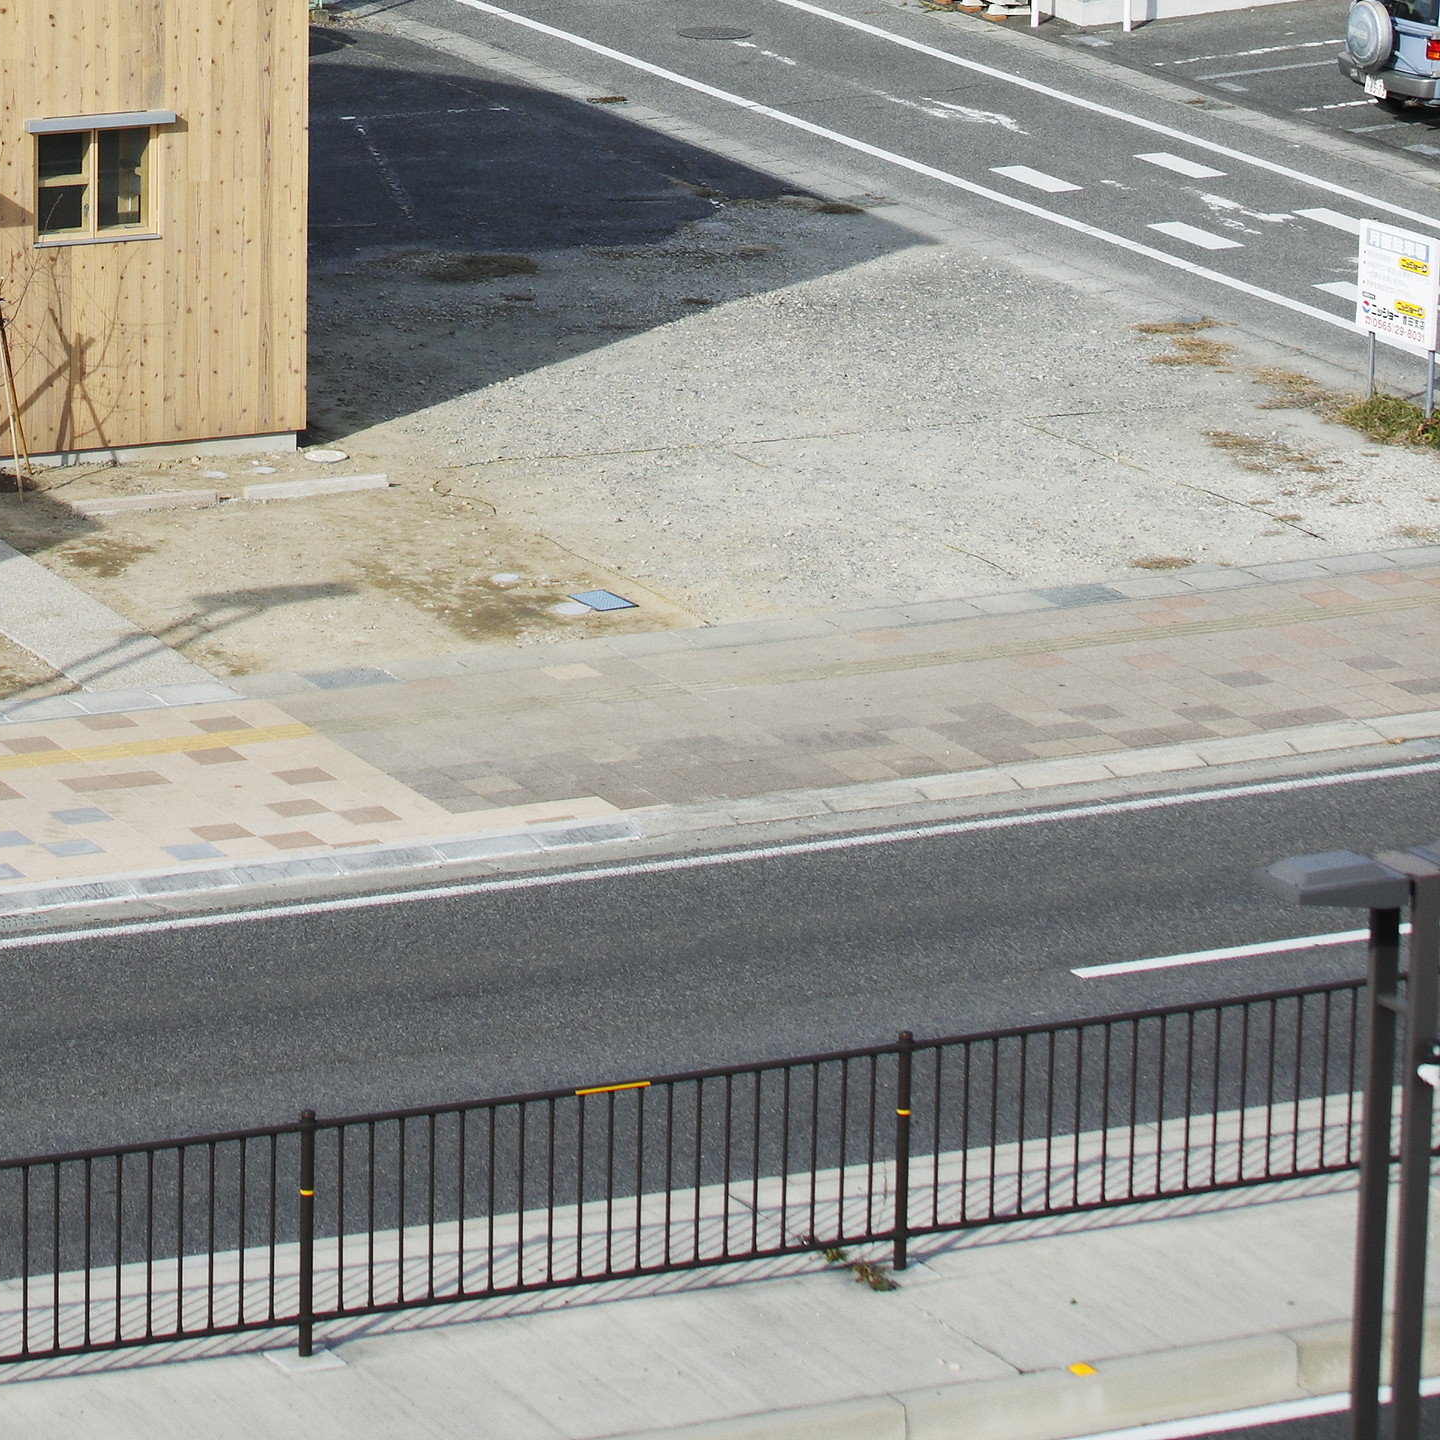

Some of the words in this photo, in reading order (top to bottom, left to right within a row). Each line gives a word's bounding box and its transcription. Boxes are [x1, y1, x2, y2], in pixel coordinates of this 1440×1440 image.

[1371, 304, 1399, 320] ニッショー
